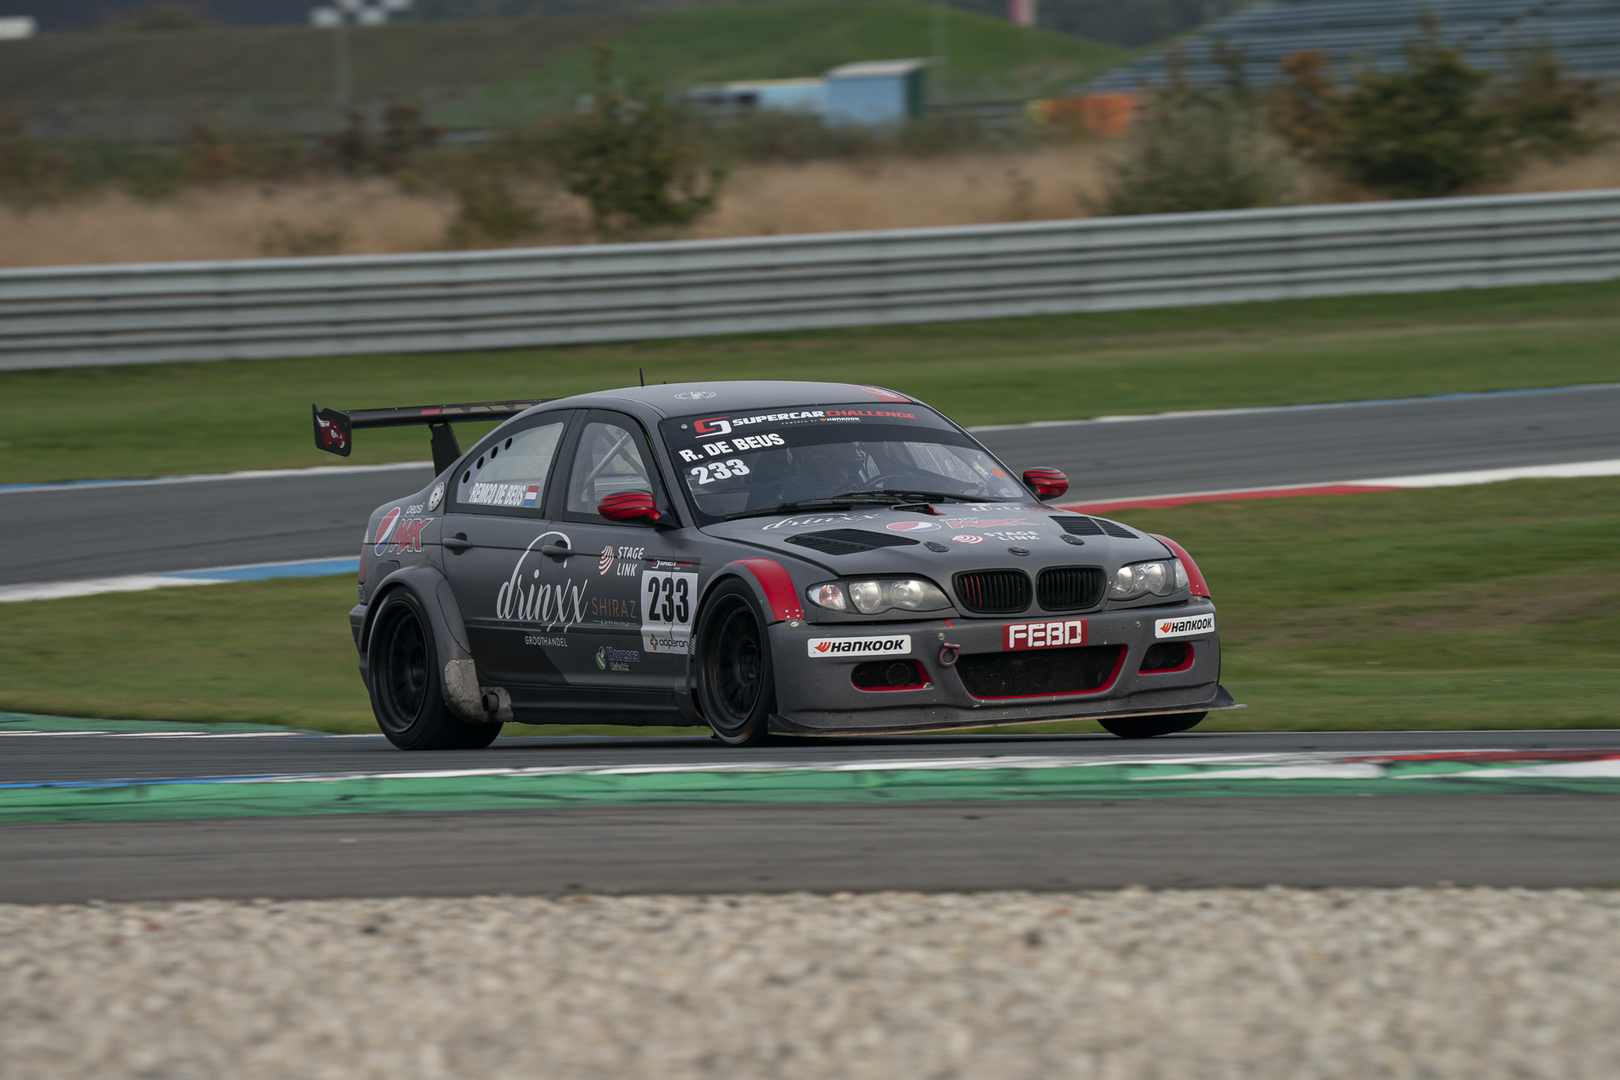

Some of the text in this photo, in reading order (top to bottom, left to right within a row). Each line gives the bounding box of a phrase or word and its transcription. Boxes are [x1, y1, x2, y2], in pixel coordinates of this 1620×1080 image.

[732, 410, 917, 427] SUPERCAR CHALLENGE
[679, 433, 785, 463] R. DE BEUS
[691, 458, 750, 485] 233
[469, 482, 526, 506] REMCO DE BEUS
[388, 517, 435, 555] MAX
[617, 546, 644, 560] STAGE
[616, 563, 637, 576] LINK
[591, 597, 637, 618] SHIRAZ
[648, 576, 689, 623] 233
[524, 635, 568, 647] GROOTHANDEL
[1009, 620, 1081, 648] FEBO
